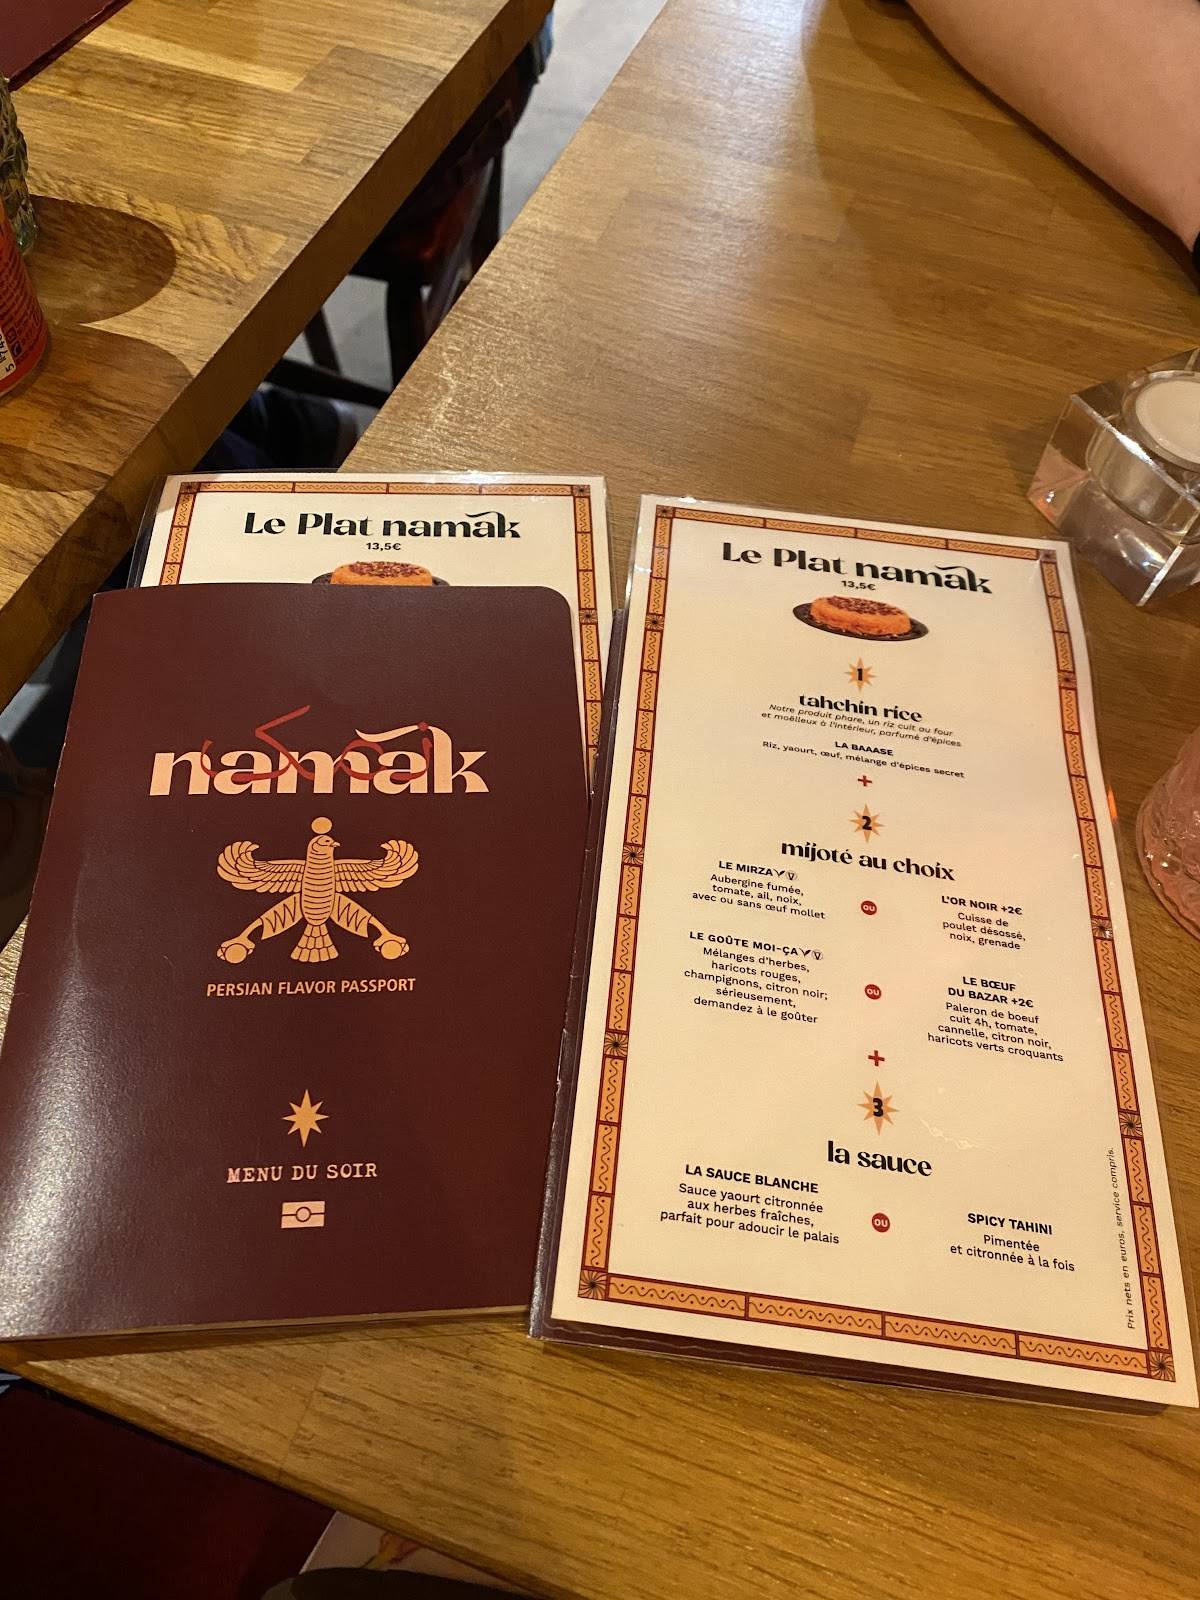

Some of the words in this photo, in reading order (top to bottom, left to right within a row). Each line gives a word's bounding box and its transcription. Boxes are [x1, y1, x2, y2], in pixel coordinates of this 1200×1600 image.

[244, 512, 286, 534] Le
[297, 513, 377, 536] Plat
[366, 542, 402, 552] 13,5€
[722, 542, 762, 564] Le
[773, 548, 849, 575] Plat
[841, 580, 876, 591] 13,5€
[856, 667, 863, 681] 1
[799, 694, 878, 716] tahchin
[883, 705, 923, 723] rice
[761, 711, 772, 719] et
[820, 719, 827, 727] à
[829, 721, 876, 736] l'intérieur,
[879, 729, 920, 742] parfumé
[922, 735, 962, 748] d'épices
[769, 704, 795, 714] Notre
[797, 708, 833, 720] produit
[834, 713, 865, 725] phare,
[868, 718, 880, 726] un
[883, 720, 895, 728] riz
[897, 722, 916, 732] cuit
[918, 726, 931, 734] au
[934, 727, 954, 737] four
[762, 741, 780, 751] Riz,
[782, 744, 818, 756] yaourt,
[820, 750, 843, 760] œuf,
[845, 753, 888, 767] mélange
[890, 761, 931, 774] d'épices
[933, 767, 965, 779] secret
[834, 741, 849, 750] LA
[851, 743, 895, 756] BAAASE
[861, 815, 874, 831] 2
[718, 860, 733, 870] LE
[736, 863, 774, 877] MIRZA
[781, 841, 853, 865] mijoté
[858, 854, 887, 871] au
[893, 858, 956, 882] choix
[710, 873, 764, 889] Aubergine
[767, 880, 804, 896] fumée,
[712, 884, 754, 899] tomate,
[757, 891, 773, 902] ail,
[776, 895, 802, 906] noix,
[692, 891, 717, 903] avec
[720, 895, 734, 905] ou
[737, 898, 762, 910] sans
[765, 901, 787, 913] œuf
[790, 906, 826, 920] mollet
[941, 895, 967, 907] L'OR
[969, 900, 998, 912] NOIR
[1001, 905, 1023, 916] +2€
[942, 920, 977, 933] poulet
[980, 926, 1027, 941] désossé,
[957, 912, 992, 925] Cuisse
[995, 918, 1009, 927] de
[689, 931, 704, 941] LE
[707, 933, 749, 948] GOÛTE
[752, 941, 799, 956] MOI-ÇA
[949, 932, 976, 944] noix,
[978, 937, 1021, 950] grenade
[703, 946, 755, 963] Mélanges
[758, 955, 810, 973] d'herbes,
[684, 969, 762, 990] champignons,
[765, 981, 799, 995] citron
[711, 960, 757, 975] haricots
[760, 969, 801, 984] rouges,
[206, 982, 273, 997] PERSIAN
[277, 980, 336, 995] FLAVOR
[341, 978, 417, 993] PASSPORT
[963, 976, 977, 986] LE
[980, 978, 1016, 992] BŒUF
[715, 987, 797, 1008] sérieusement,
[948, 987, 965, 997] DU
[968, 990, 1008, 1004] BAZAR
[1011, 997, 1034, 1008] +2€
[693, 996, 753, 1013] demandez
[756, 1004, 764, 1015] à
[766, 1006, 777, 1017] le
[780, 1009, 818, 1024] goûter
[946, 1002, 987, 1016] Paleron
[991, 1009, 1005, 1018] de
[1008, 1010, 1039, 1024] boeuf
[938, 1024, 988, 1040] cannelle,
[991, 1032, 1024, 1044] citron
[949, 1014, 971, 1024] cuit
[974, 1017, 992, 1029] 4h,
[995, 1020, 1038, 1036] tomate,
[927, 1032, 973, 1048] haricots
[976, 1041, 1005, 1053] verts
[1008, 1046, 1064, 1062] croquants
[872, 1097, 884, 1118] 3
[827, 1140, 850, 1165] la
[856, 1150, 933, 1177] sauce
[226, 1166, 284, 1184] MENU
[291, 1164, 319, 1181] DU
[326, 1162, 378, 1179] SOIR
[685, 1164, 702, 1177] LA
[705, 1166, 751, 1184] SAUCE
[754, 1173, 819, 1193] BLANCHE
[678, 1182, 717, 1198] Sauce
[720, 1190, 761, 1204] yaourt
[764, 1194, 824, 1213] citronnée
[1112, 1191, 1123, 1227] service
[687, 1200, 710, 1211] aux
[713, 1201, 757, 1219] herbes
[760, 1208, 815, 1227] fraîches,
[874, 1218, 889, 1228] OU
[967, 1212, 1006, 1228] SPICY
[1008, 1218, 1053, 1235] TAHINI
[660, 1209, 702, 1226] parfait
[705, 1216, 735, 1230] pour
[738, 1220, 786, 1236] adoucir
[788, 1227, 799, 1238] le
[803, 1229, 840, 1245] palais
[983, 1234, 1040, 1252] Pimentée
[1118, 1230, 1128, 1262] euros,
[950, 1244, 963, 1255] et
[966, 1246, 1024, 1264] citronnée
[1027, 1253, 1036, 1266] à
[1038, 1256, 1050, 1268] la
[1052, 1258, 1075, 1272] fois
[1122, 1267, 1130, 1279] en
[1123, 1281, 1132, 1306] nets
[1127, 1309, 1136, 1330] Prix
